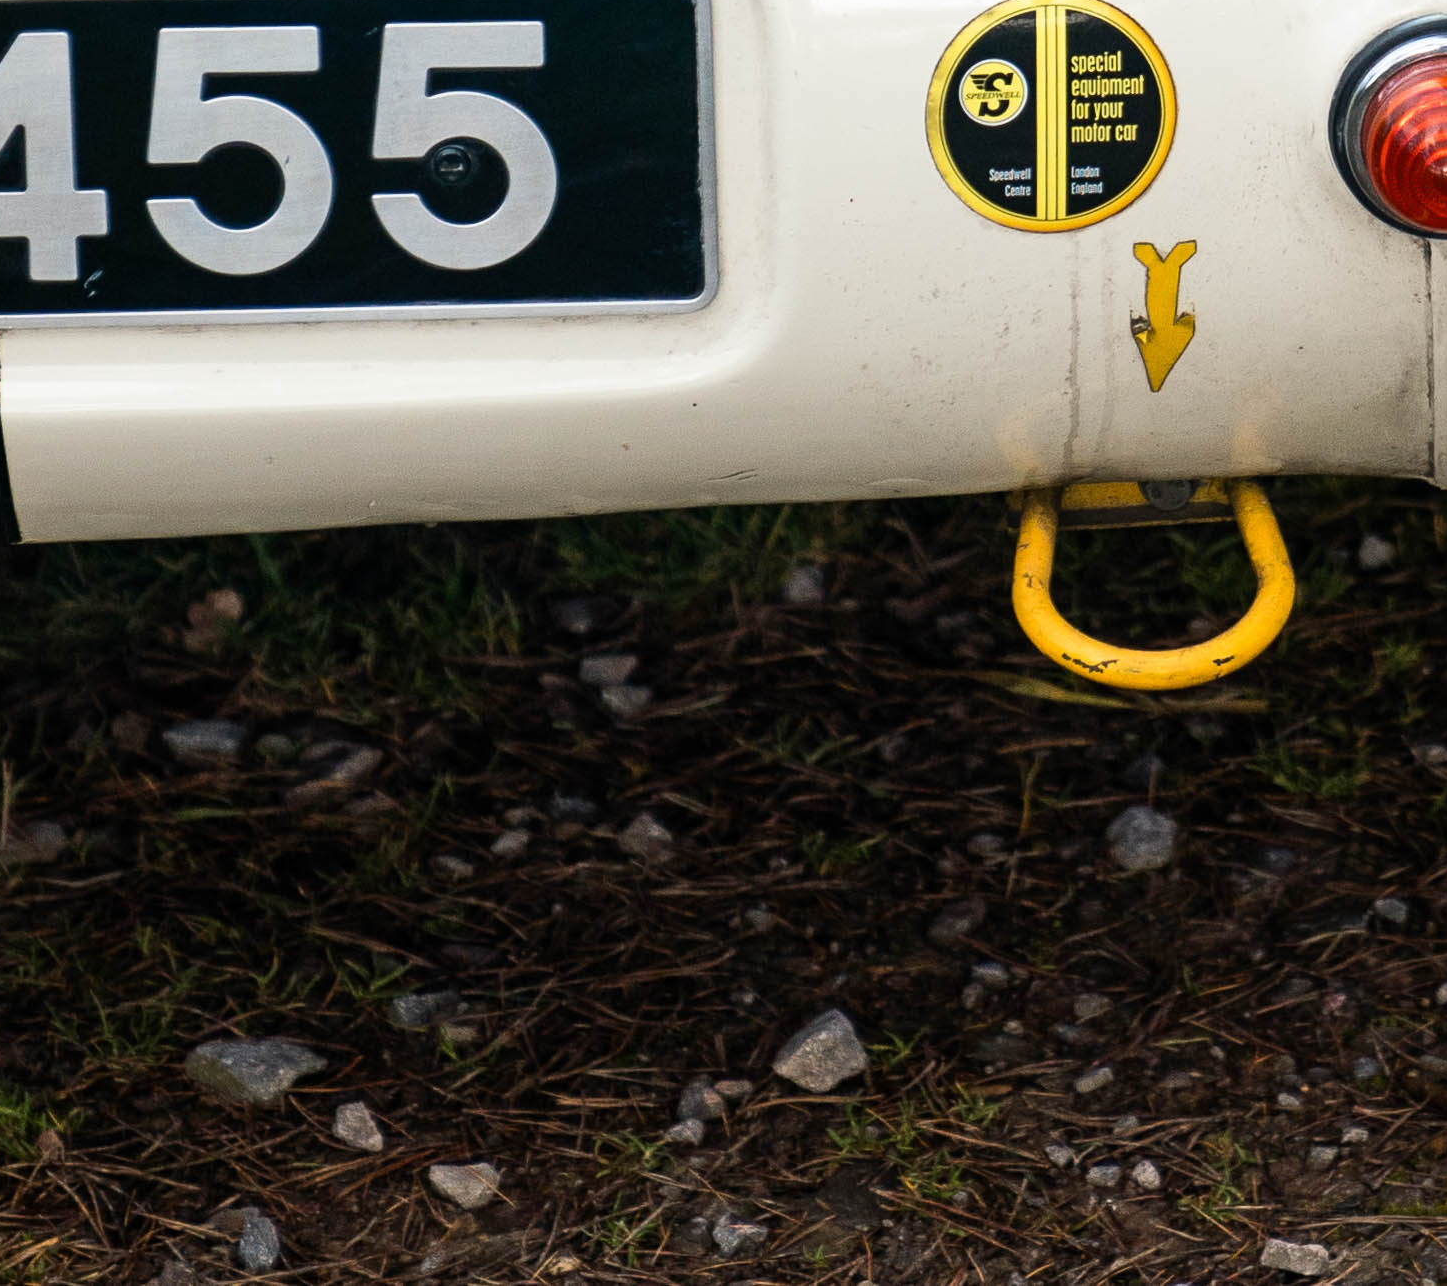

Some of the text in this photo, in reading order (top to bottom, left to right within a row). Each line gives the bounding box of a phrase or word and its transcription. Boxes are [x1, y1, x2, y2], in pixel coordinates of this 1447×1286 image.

[1070, 50, 1123, 75] special
[964, 91, 1022, 101] SPEEDWELL
[1070, 74, 1145, 98] equipment
[1070, 99, 1124, 122] for your
[1070, 122, 1139, 144] motor car
[988, 165, 1101, 182] Speedwell London
[1004, 181, 1103, 198] Centre England
